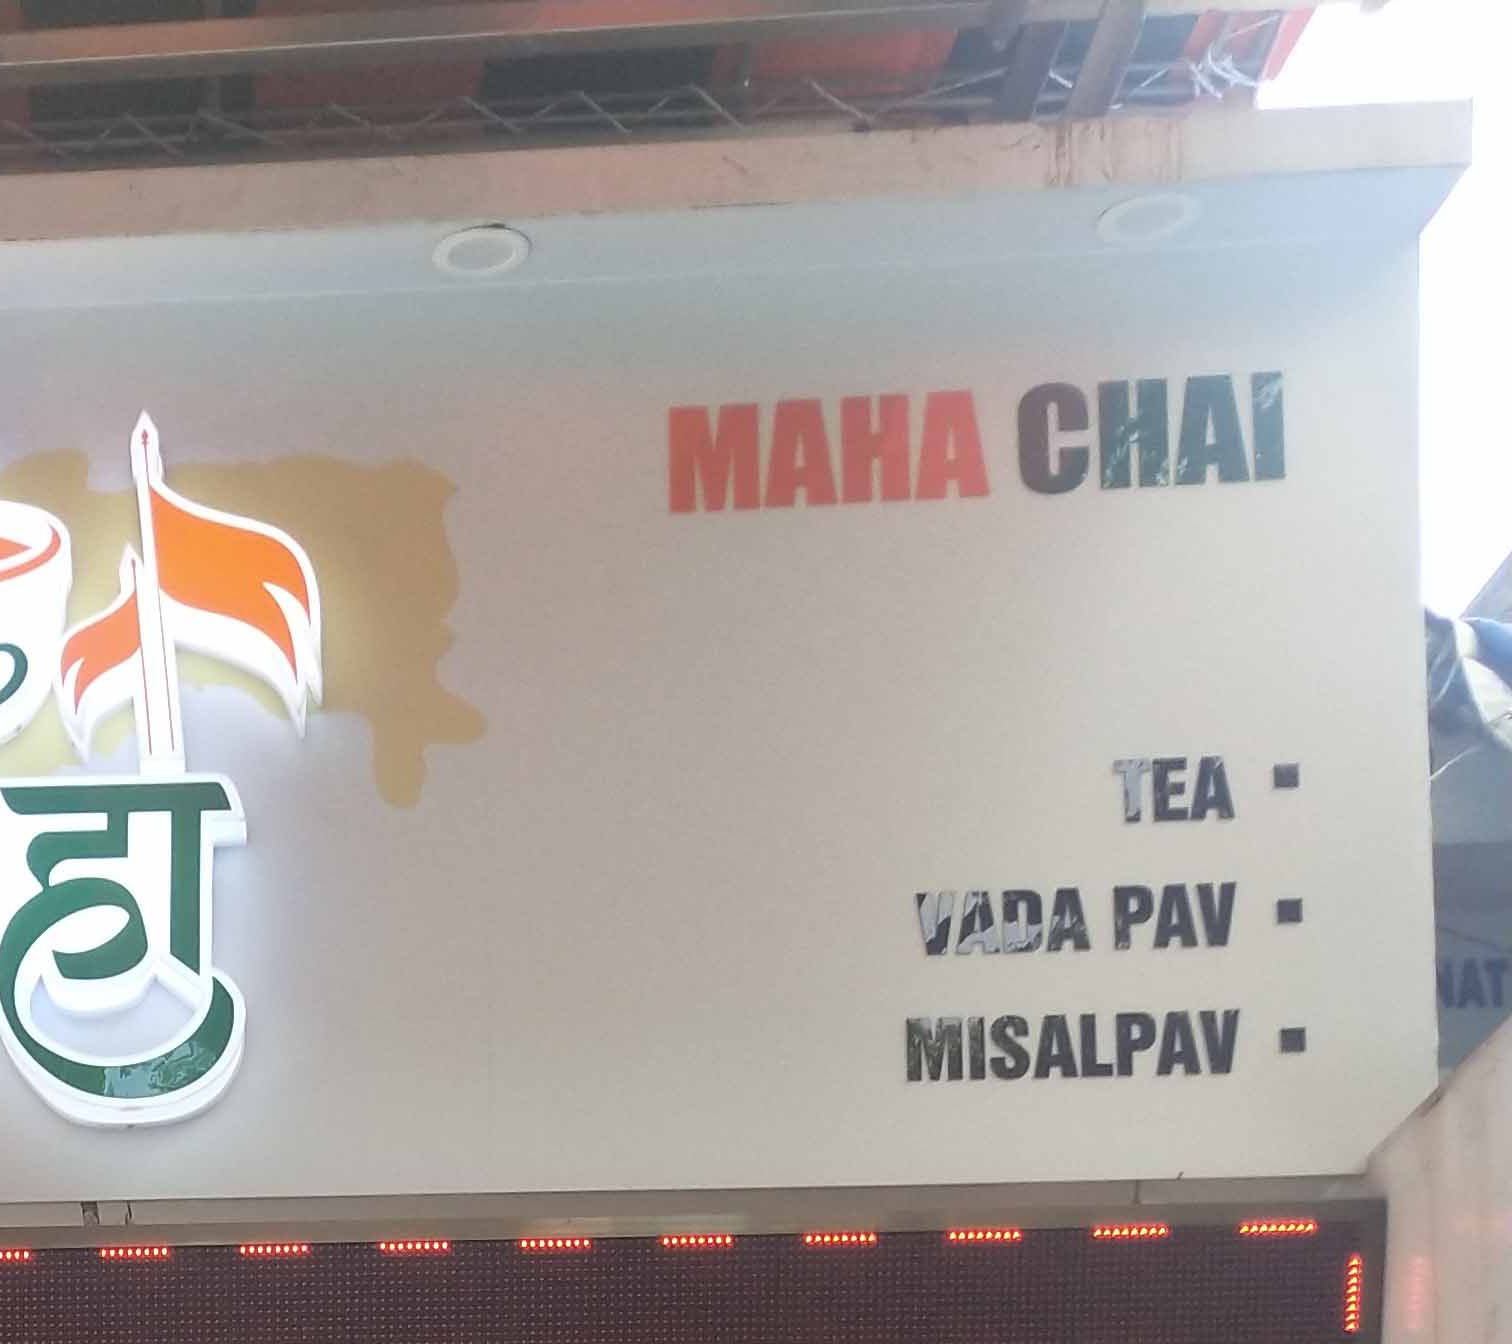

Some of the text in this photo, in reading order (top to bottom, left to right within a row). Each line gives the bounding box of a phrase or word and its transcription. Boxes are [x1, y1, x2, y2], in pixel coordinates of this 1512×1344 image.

[668, 371, 1286, 514] MAHA CHAI
[1111, 756, 1235, 823] TEA
[916, 881, 1237, 955] VADA PAV
[906, 1009, 1240, 1082] MISALPAV
